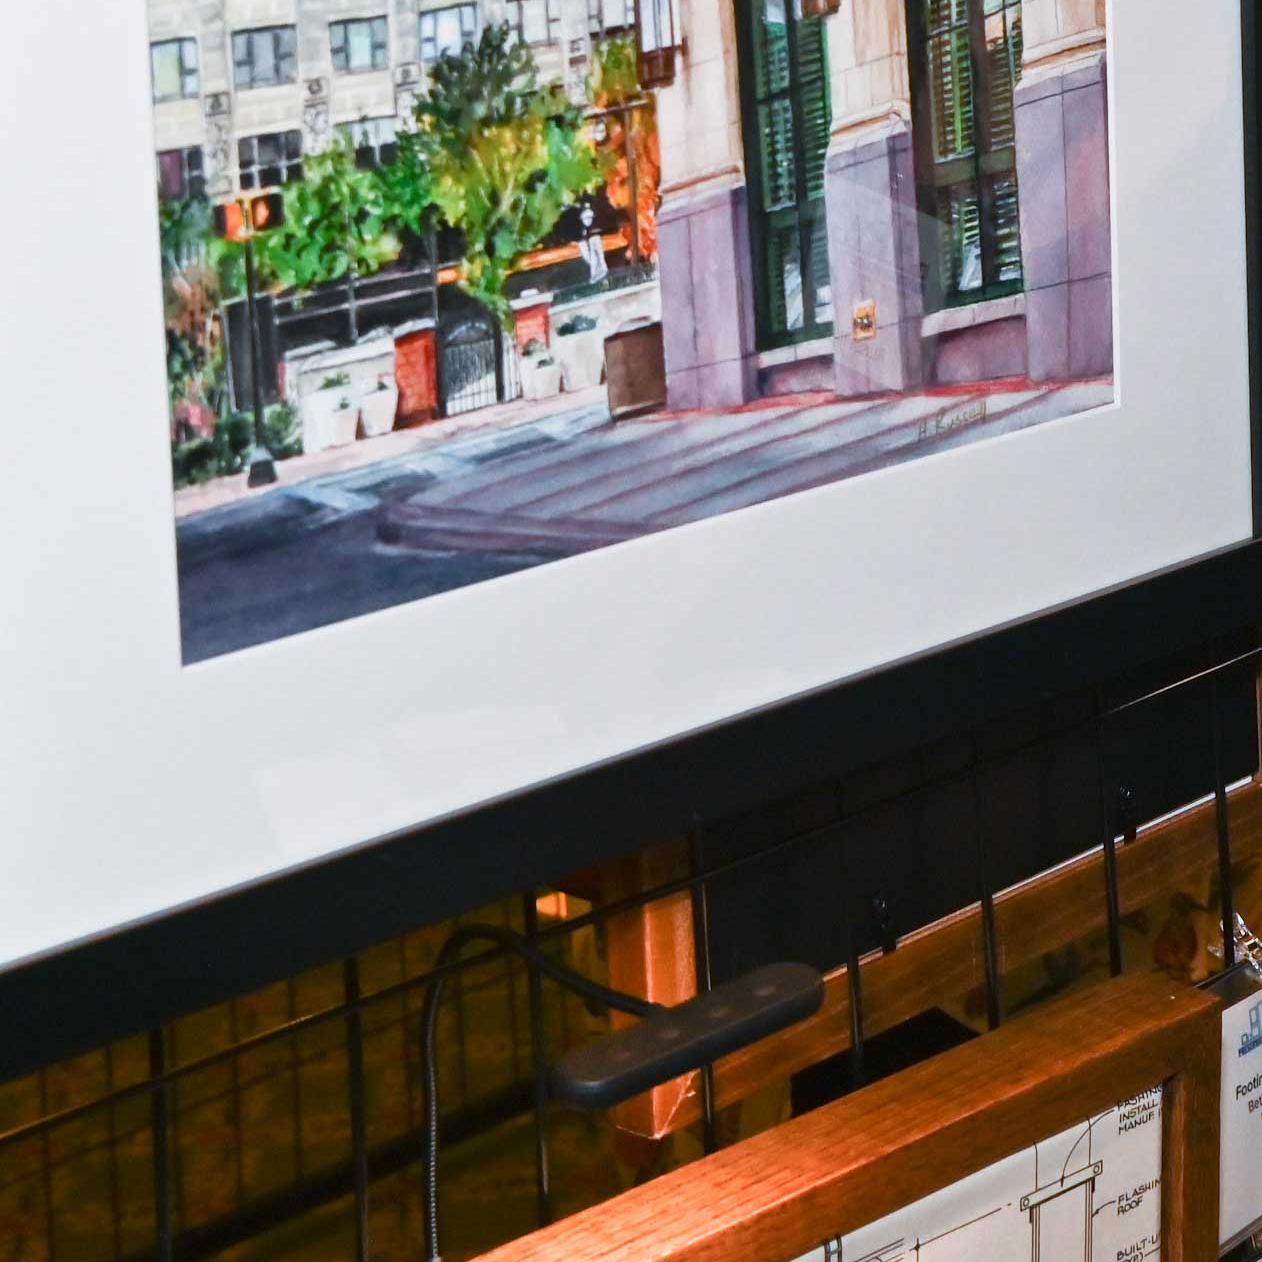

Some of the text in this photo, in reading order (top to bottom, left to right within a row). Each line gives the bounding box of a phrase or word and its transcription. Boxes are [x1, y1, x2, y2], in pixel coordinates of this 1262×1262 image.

[1119, 1098, 1158, 1123] INSTALL
[1117, 1195, 1143, 1216] ROOF
[1117, 1233, 1160, 1261] BUILT-U
